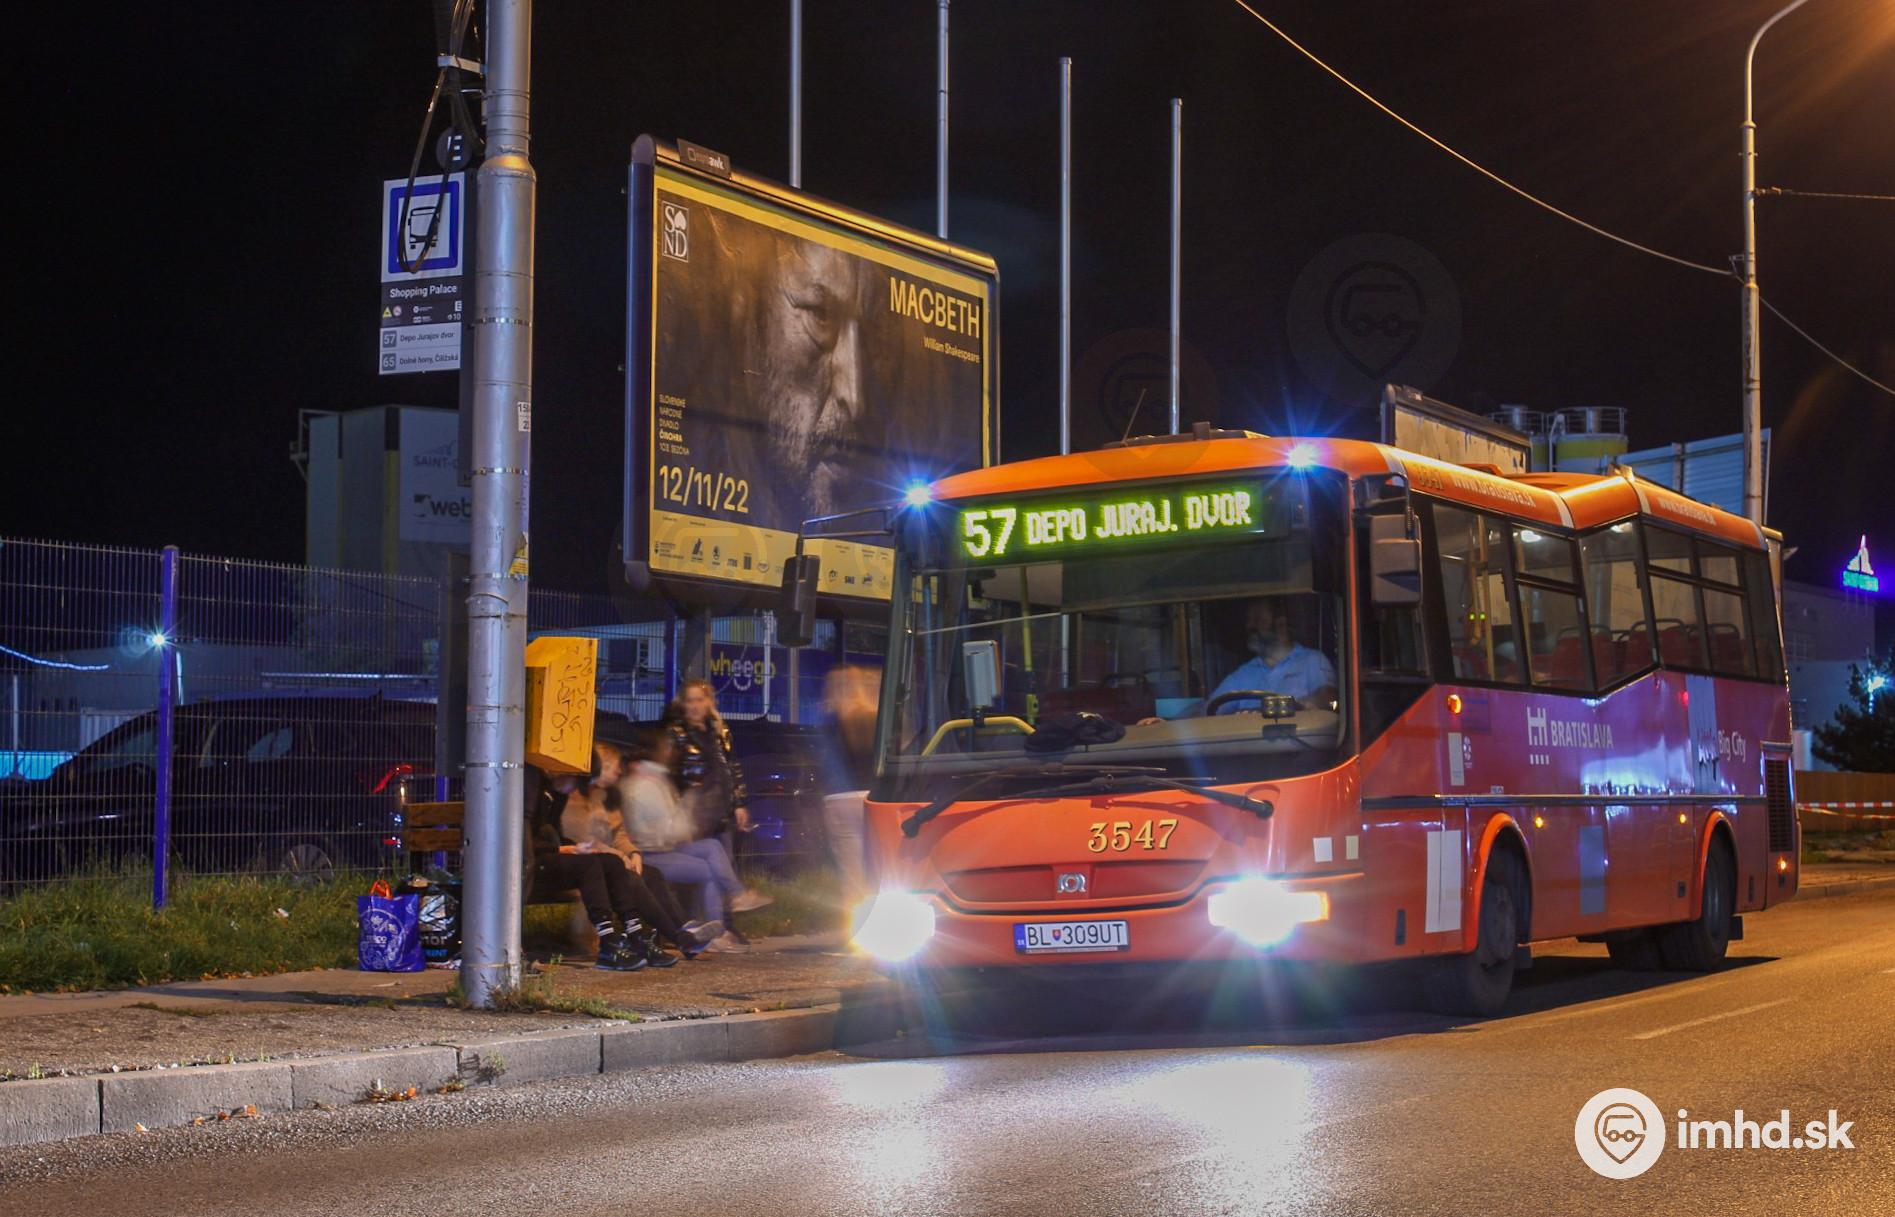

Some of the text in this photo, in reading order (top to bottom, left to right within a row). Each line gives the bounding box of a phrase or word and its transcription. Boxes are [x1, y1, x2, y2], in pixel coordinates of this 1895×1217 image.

[389, 284, 458, 299] Shopping Palace
[890, 276, 980, 339] MACBETH
[383, 333, 396, 345] 57
[400, 334, 416, 342] Depo
[440, 331, 455, 339] dvor
[944, 342, 981, 364] Shakespeare
[383, 356, 395, 368] 65
[659, 465, 749, 513] 12/11/22
[962, 491, 1252, 558] 57 DEPO JURAJ. DVOR
[1550, 718, 1614, 749] BRATISLAVA
[1717, 729, 1732, 762] Big
[1732, 730, 1747, 763] City
[1087, 818, 1179, 853] 3547
[1027, 925, 1051, 947] BL
[1063, 923, 1124, 945] 309UT
